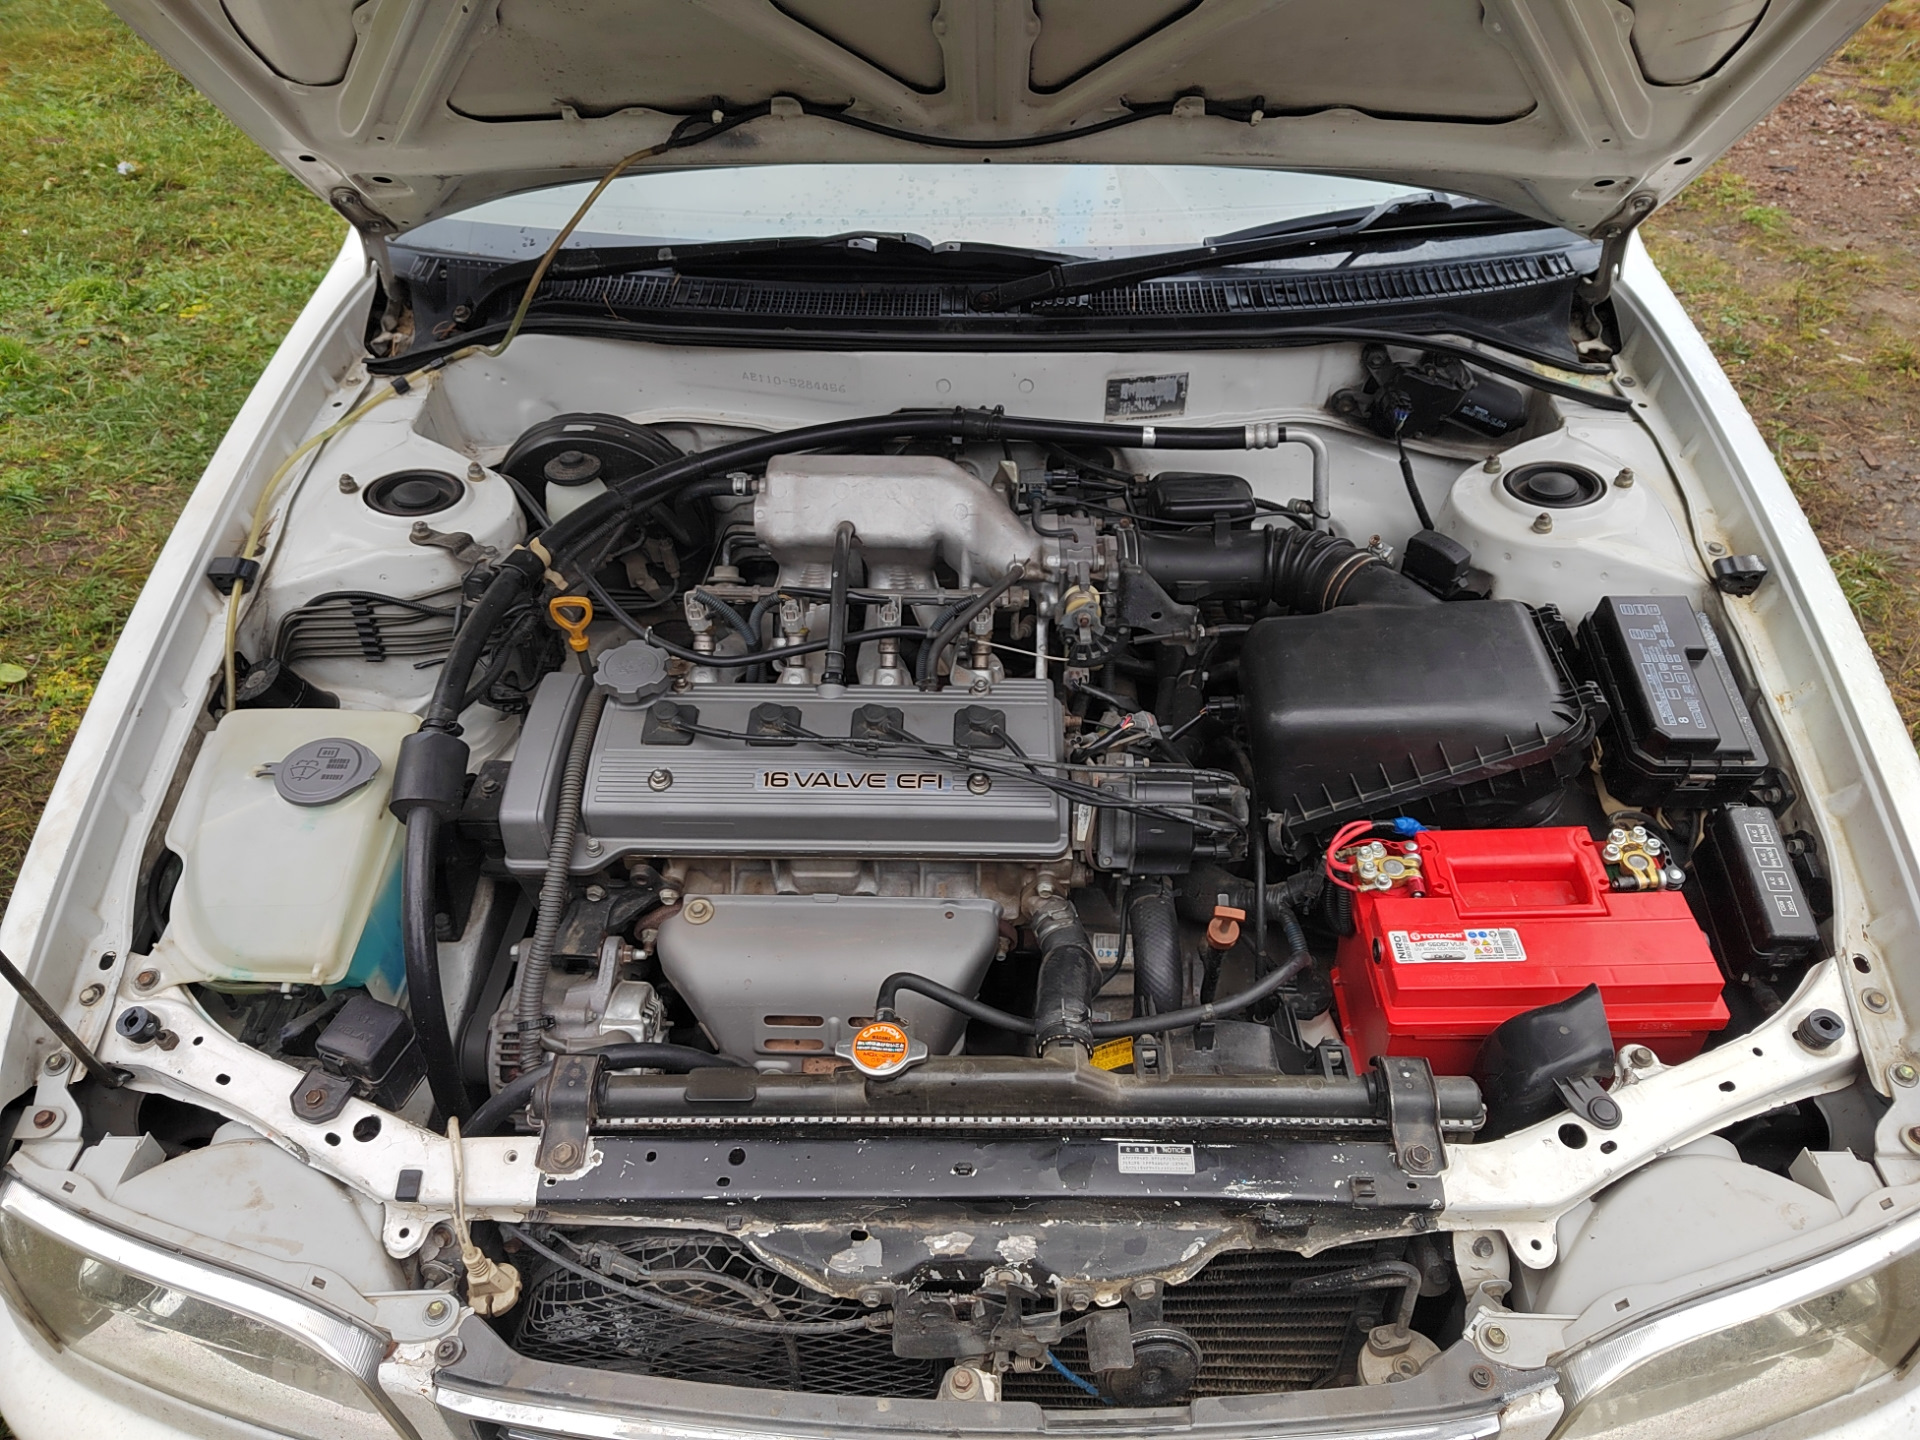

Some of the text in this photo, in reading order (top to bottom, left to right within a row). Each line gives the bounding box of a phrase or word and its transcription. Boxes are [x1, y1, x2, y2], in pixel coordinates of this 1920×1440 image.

[1677, 716, 1690, 724] 8
[763, 771, 943, 789] 16 VALVE EFI
[1393, 935, 1406, 959] NIRO
[862, 1026, 901, 1039] CAUTION
